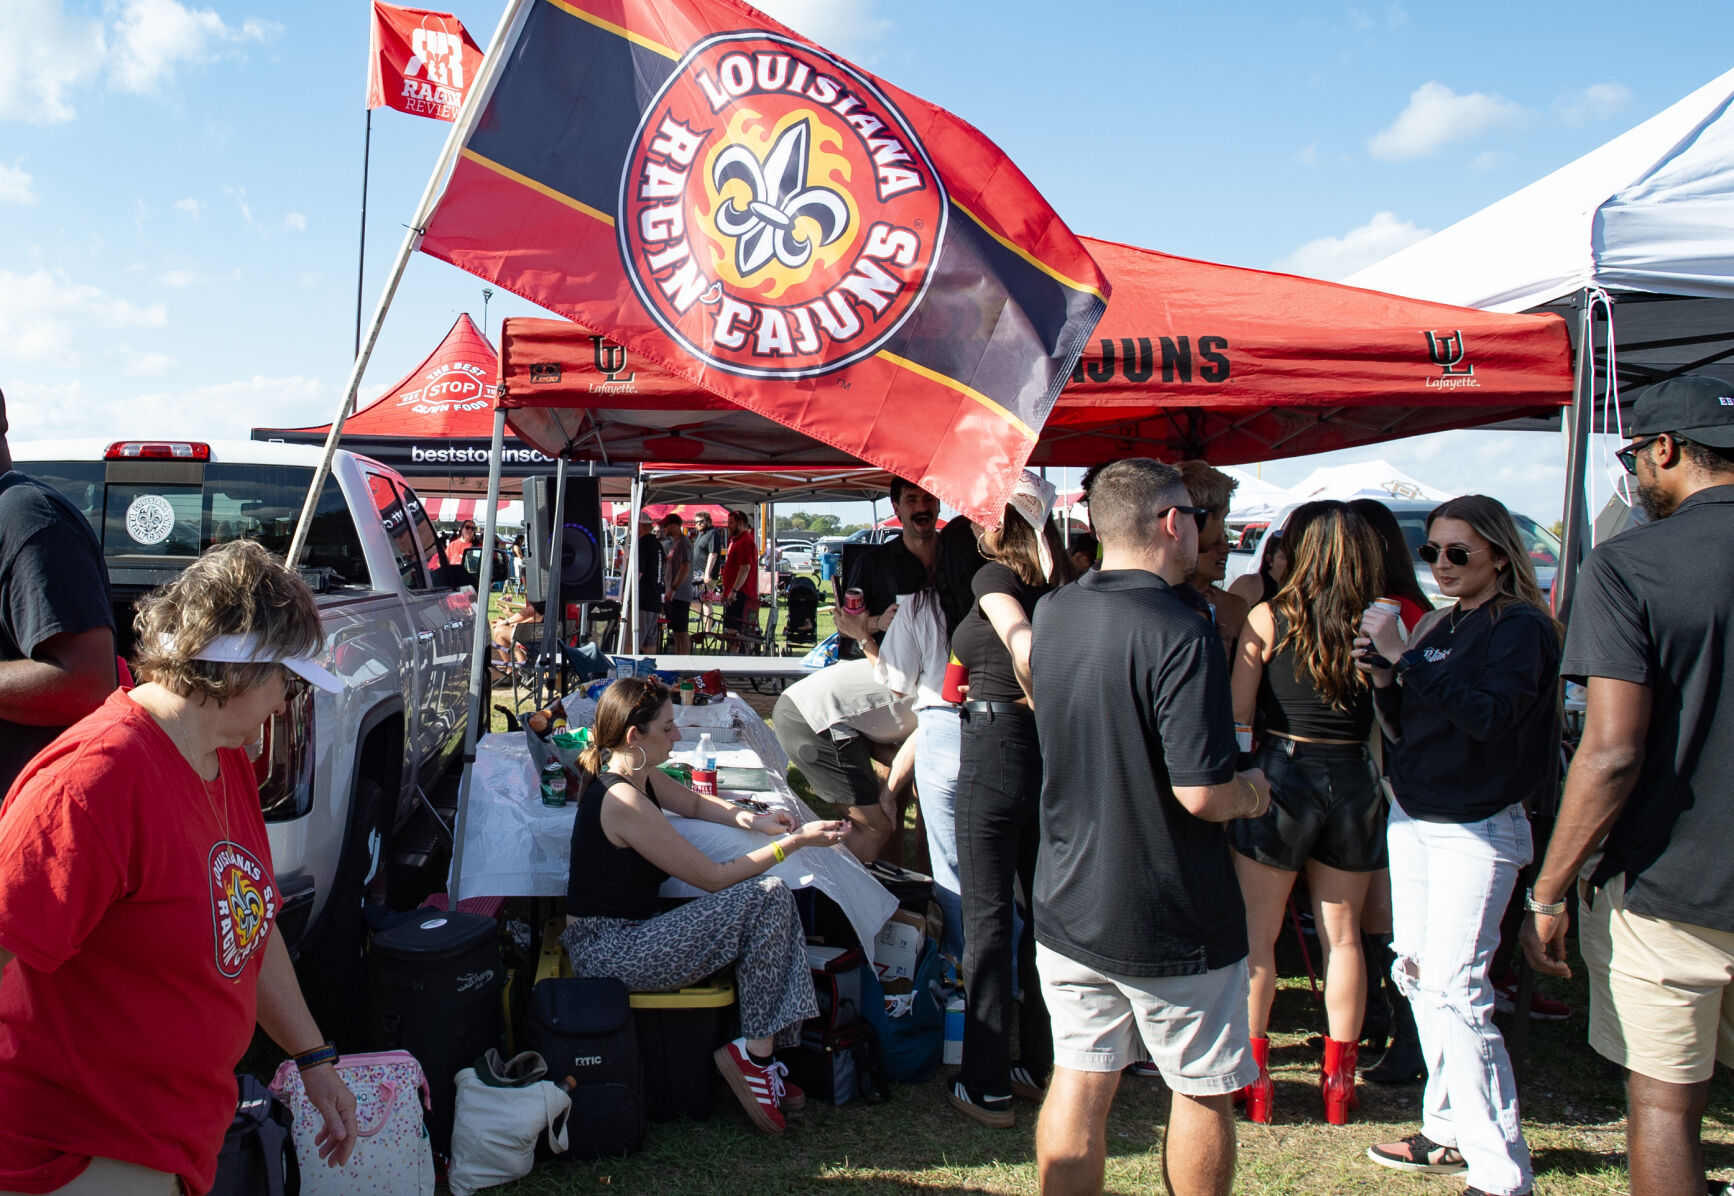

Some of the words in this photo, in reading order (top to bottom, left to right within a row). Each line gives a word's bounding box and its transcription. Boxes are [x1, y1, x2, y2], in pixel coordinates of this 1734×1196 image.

[696, 51, 926, 202] LOUISIANA
[708, 221, 921, 357] CAJUNS
[1072, 336, 1230, 383] JUNS
[426, 365, 450, 380] THE
[453, 362, 487, 376] BEST
[429, 381, 475, 397] STOP
[587, 383, 636, 397] Lafayette
[1425, 377, 1477, 390] Lafayette
[453, 400, 488, 412] FOOD
[575, 1056, 602, 1066] RTIC
